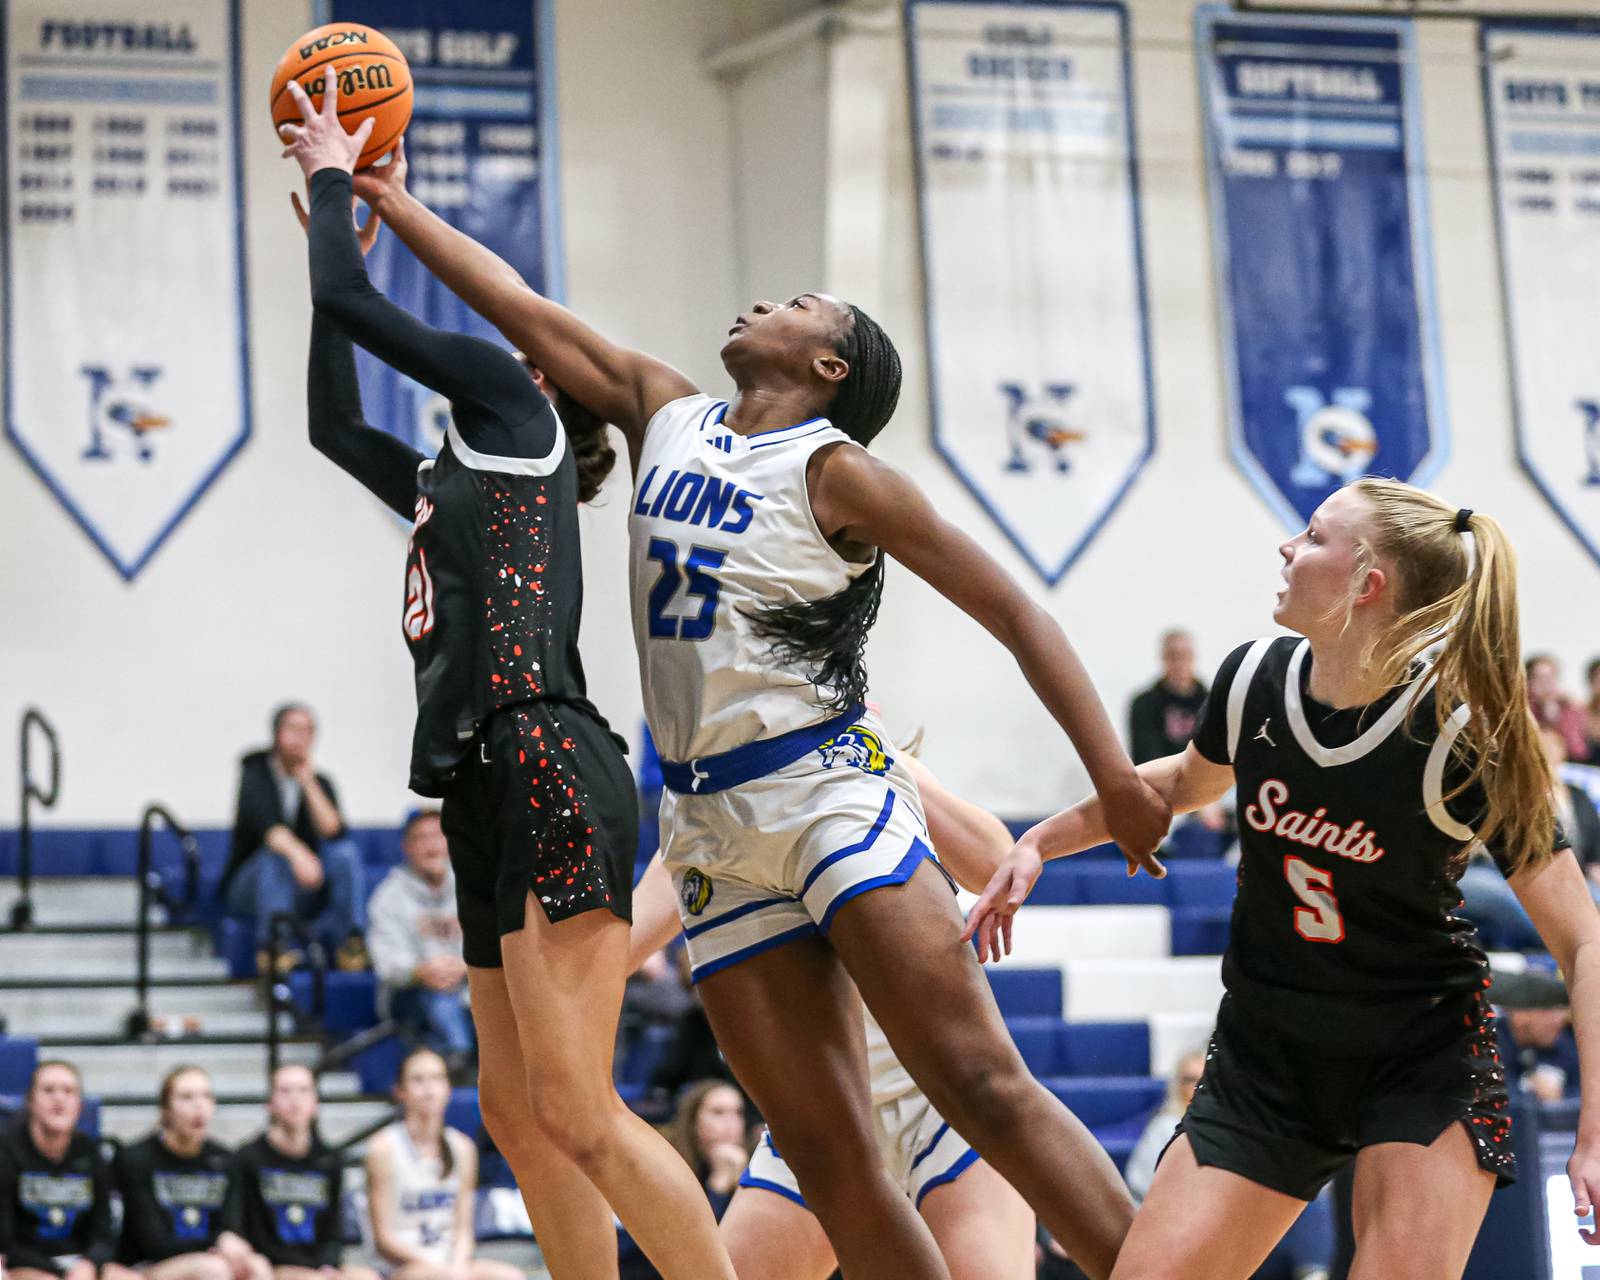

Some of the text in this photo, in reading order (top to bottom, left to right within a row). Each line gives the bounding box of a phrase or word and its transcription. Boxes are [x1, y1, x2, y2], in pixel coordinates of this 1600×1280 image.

[41, 20, 196, 52] FOOTBALL
[300, 31, 368, 60] NCAA
[303, 63, 394, 98] Wilo
[634, 465, 765, 535] LIONS
[646, 536, 730, 642] 25
[1245, 778, 1385, 864] Saints
[1283, 854, 1345, 945] 5
